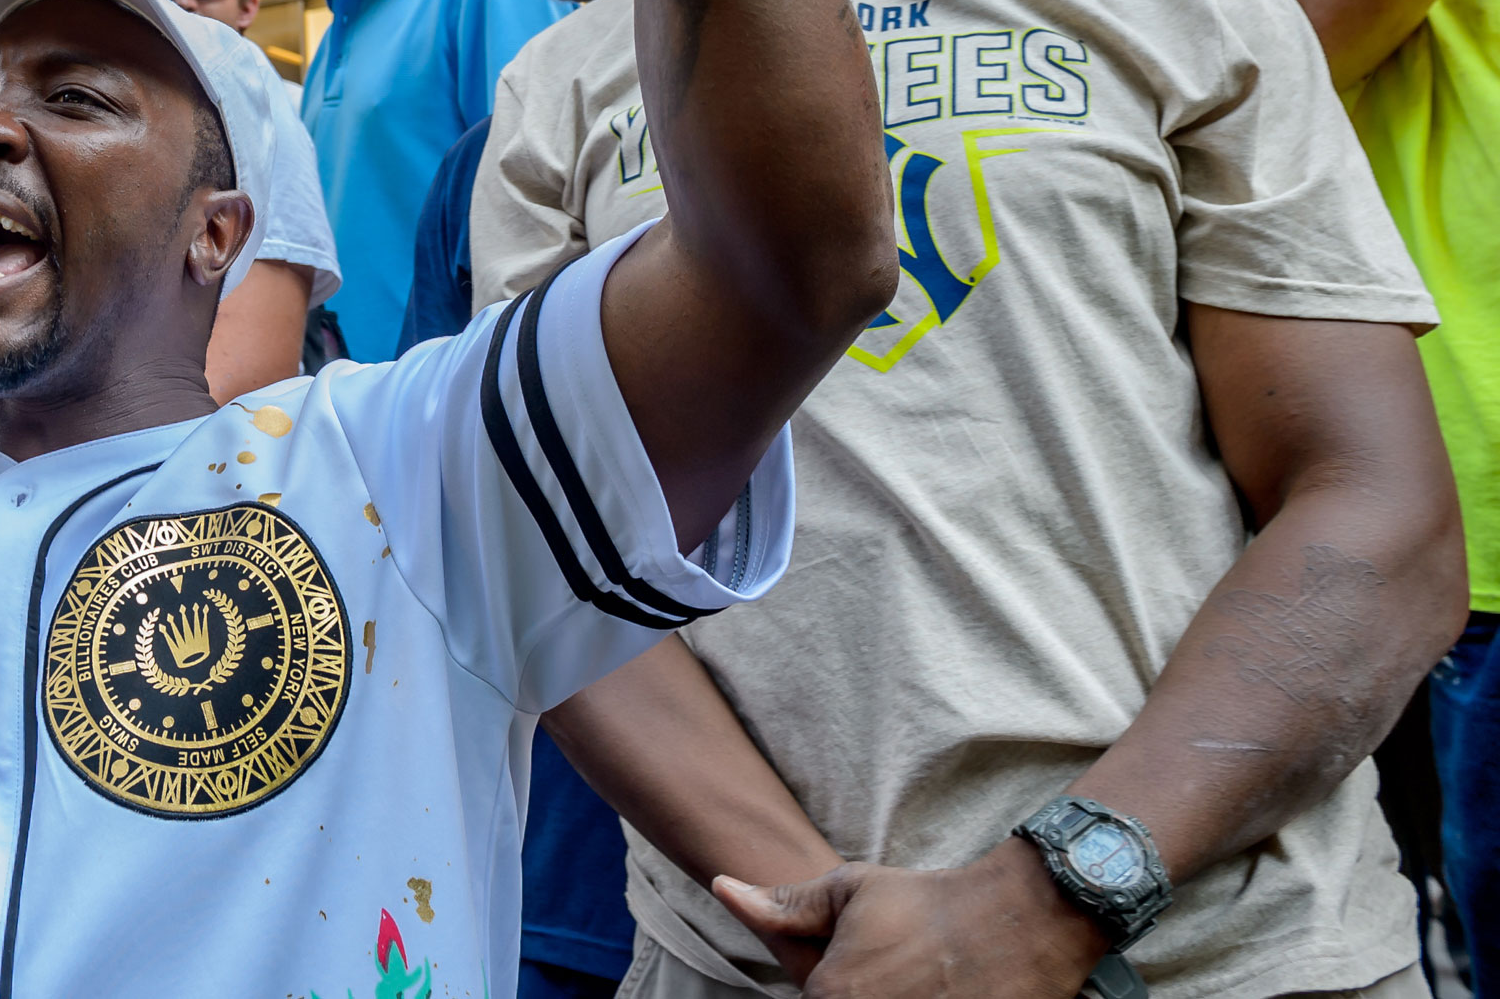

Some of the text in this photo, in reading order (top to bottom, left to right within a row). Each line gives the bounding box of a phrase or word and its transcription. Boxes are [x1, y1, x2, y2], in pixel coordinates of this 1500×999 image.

[857, 0, 930, 32] ORK
[190, 540, 286, 581] SWT DISTRICT
[78, 554, 160, 682] BILLIONAIRES CLUB
[281, 613, 308, 705] NEW YORK
[99, 714, 140, 752] SWAG
[178, 726, 268, 767] SELF MADE
